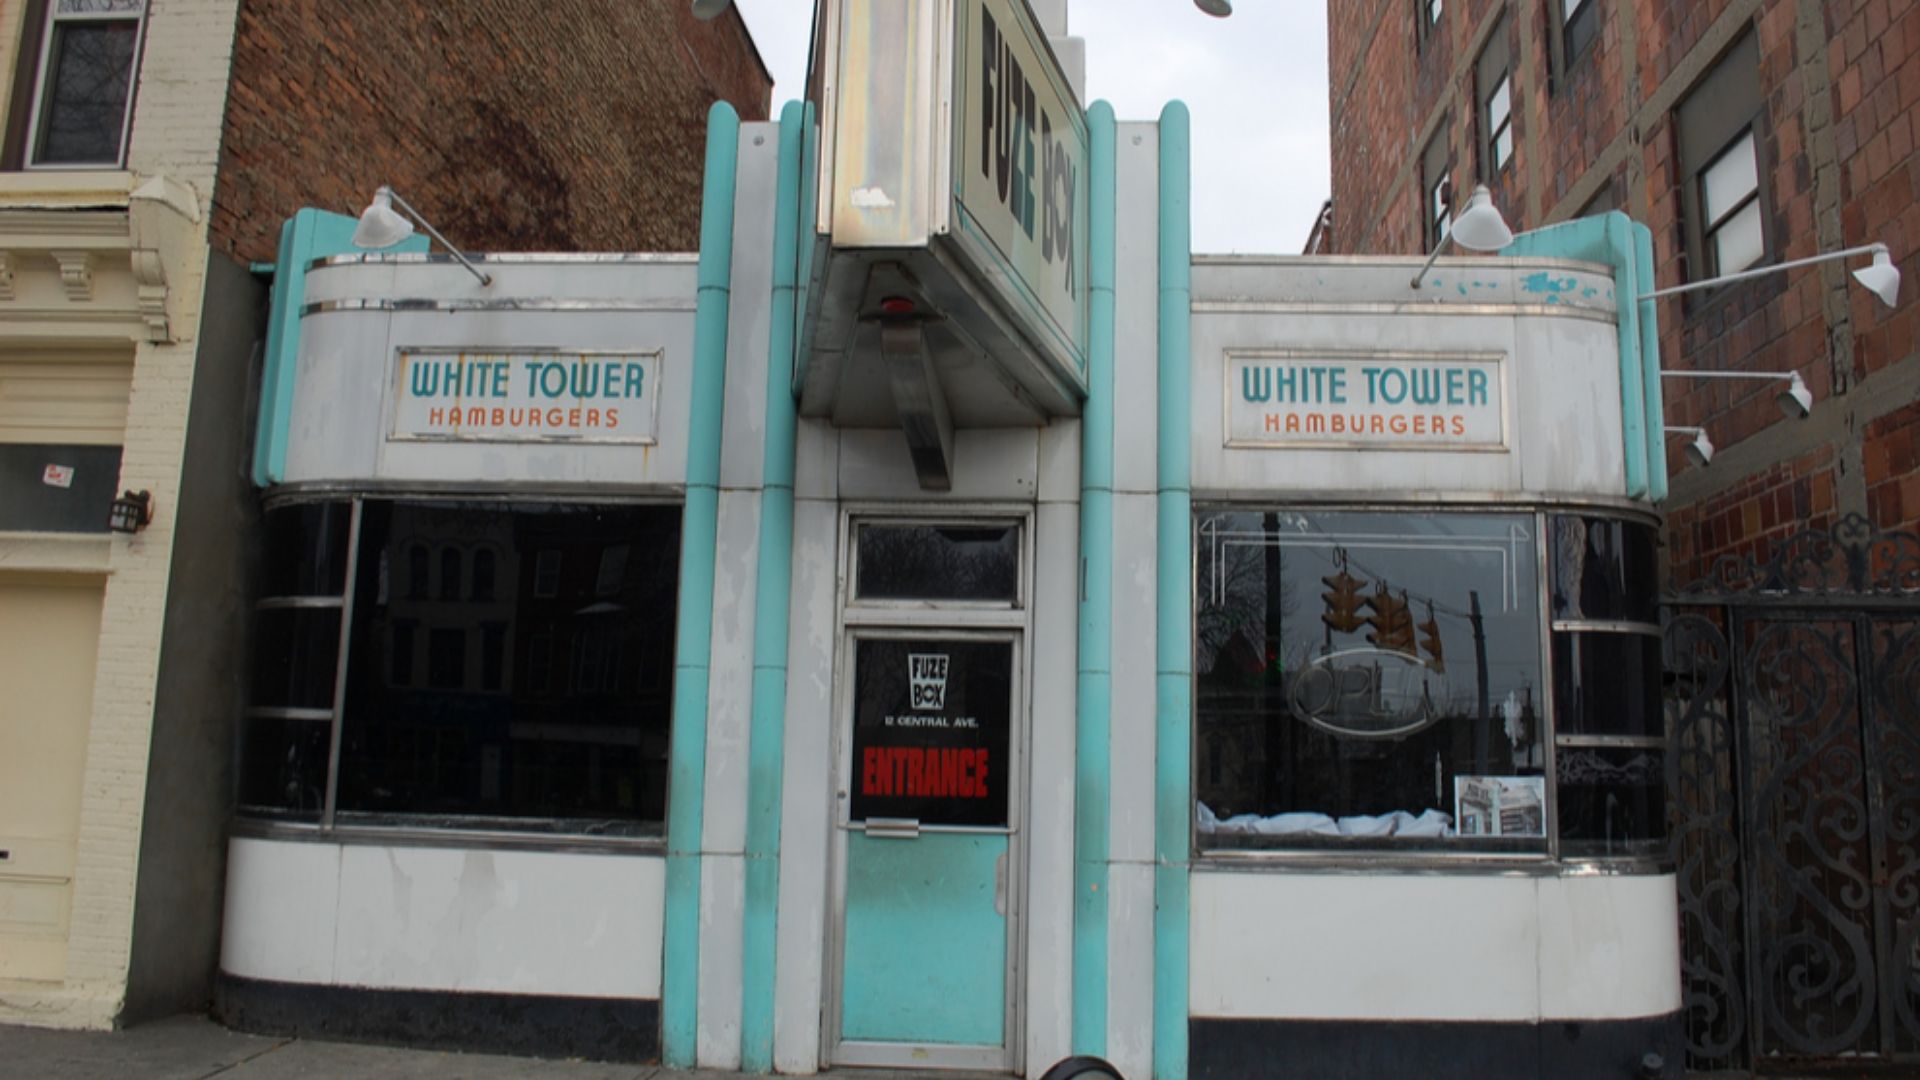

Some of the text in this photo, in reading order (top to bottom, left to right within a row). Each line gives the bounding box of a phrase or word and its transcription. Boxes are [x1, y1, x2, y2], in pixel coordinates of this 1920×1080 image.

[981, 2, 1076, 301] FUZE BOX
[411, 361, 645, 399] WHITE TOWER
[1242, 366, 1488, 406] WHITE TOWER
[429, 406, 620, 428] HAMBURGERS
[1265, 413, 1466, 436] HAMBURGERS
[911, 656, 947, 680] FUZE
[913, 683, 944, 708] BOX
[897, 716, 949, 727] CENTRAL
[863, 747, 988, 798] ENTRANCE
